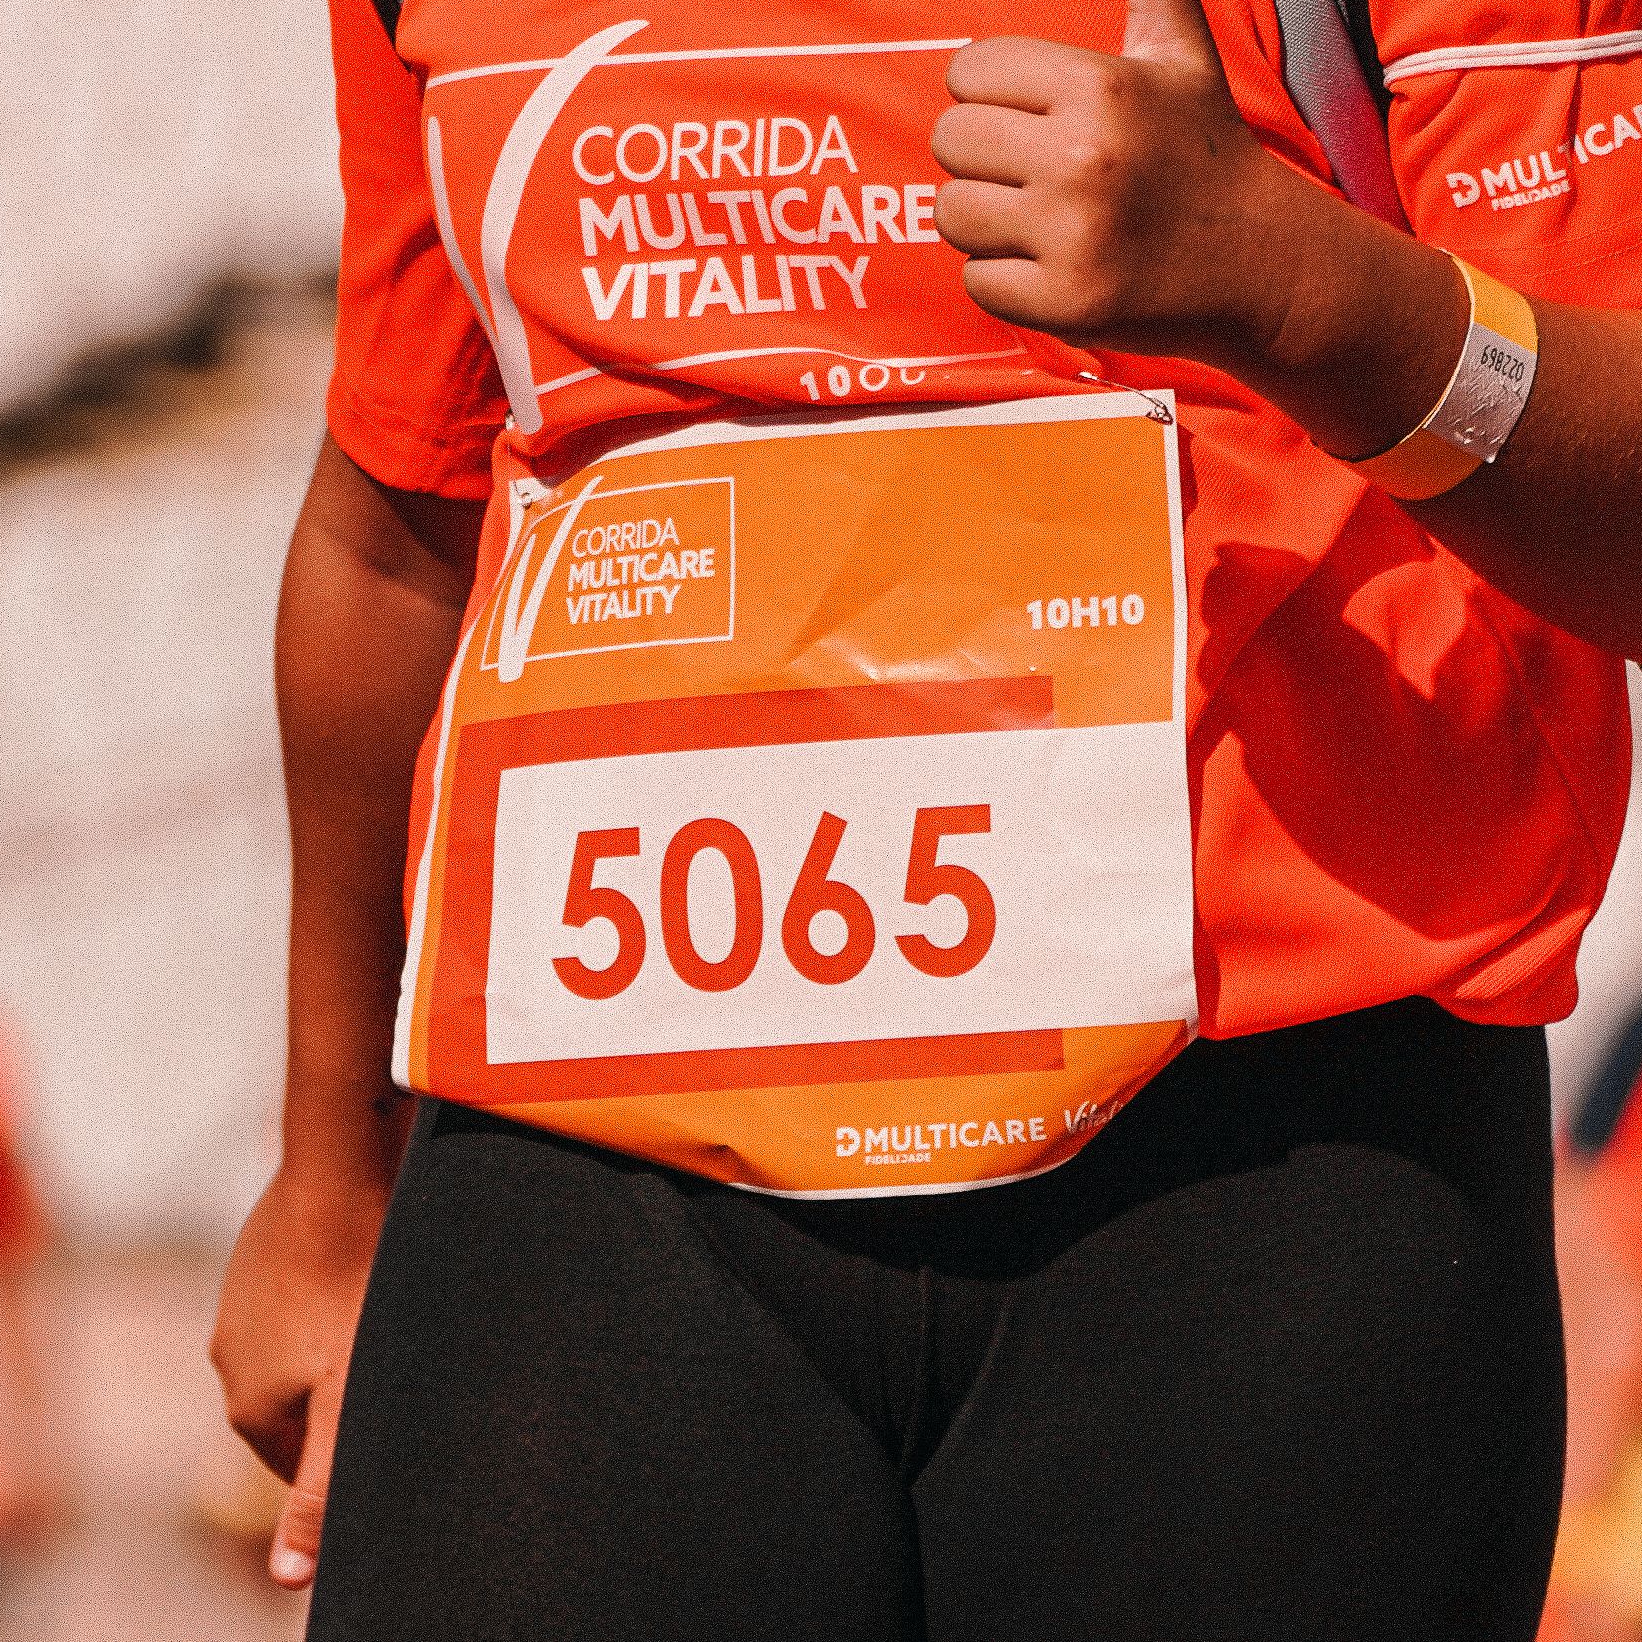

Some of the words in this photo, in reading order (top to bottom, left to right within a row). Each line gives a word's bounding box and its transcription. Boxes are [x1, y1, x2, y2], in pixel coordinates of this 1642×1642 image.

[572, 115, 858, 186] CORRIDA
[578, 184, 942, 256] MULTICARE
[581, 255, 871, 321] VITALITY
[571, 517, 681, 558] CORRIDA
[567, 548, 716, 592] MULTICARE
[565, 584, 682, 625] VITALITY
[1026, 593, 1146, 631] 10H10
[551, 804, 997, 1001] 5065
[864, 1117, 1048, 1154] MULTICARE
